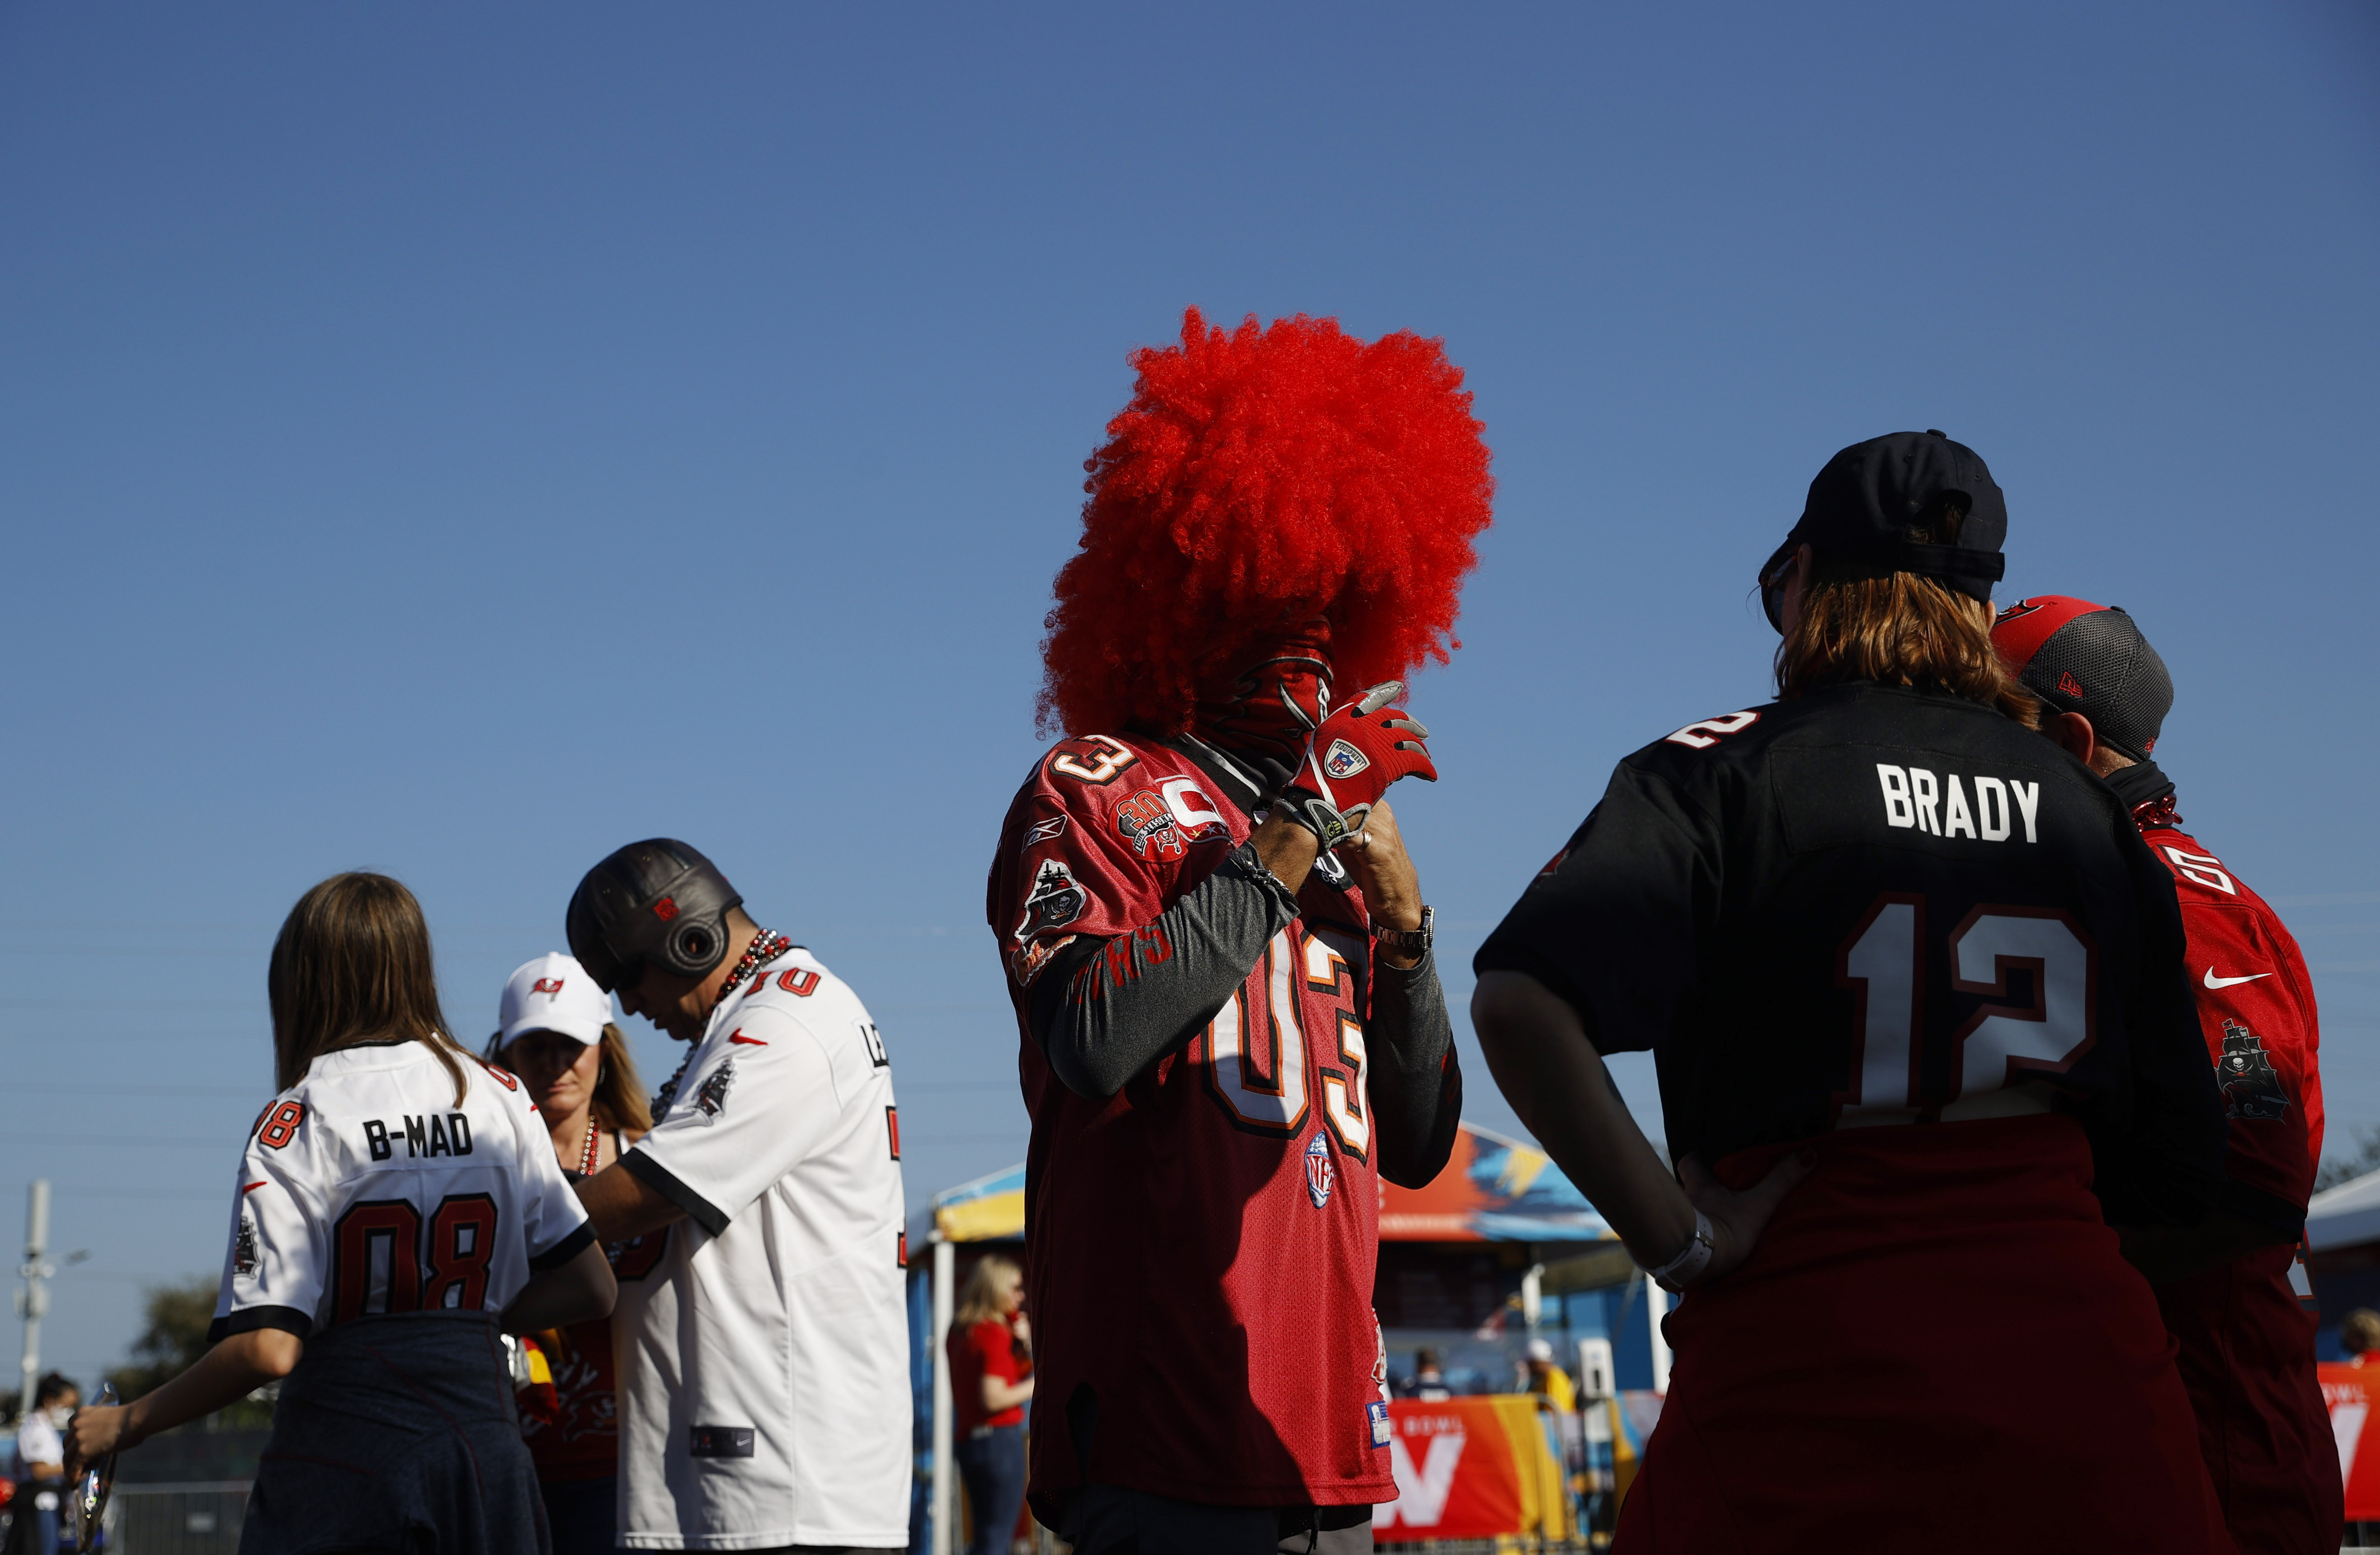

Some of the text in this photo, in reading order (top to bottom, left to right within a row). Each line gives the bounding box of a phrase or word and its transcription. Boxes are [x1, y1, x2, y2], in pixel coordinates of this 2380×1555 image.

[1664, 710, 1762, 750] 2
[1023, 734, 1141, 786] 3
[1329, 758, 1348, 773] NFL
[1335, 743, 1364, 766] EQUIPMENT
[1117, 790, 1168, 831] 30
[1162, 779, 1226, 827] C
[1876, 763, 2039, 844] BRADY
[1135, 813, 1172, 844] 1976 SEASONS
[1321, 872, 1338, 884] 63
[1831, 890, 2100, 1130] 12
[363, 1113, 473, 1161] B-MAD
[333, 1192, 498, 1325] 08
